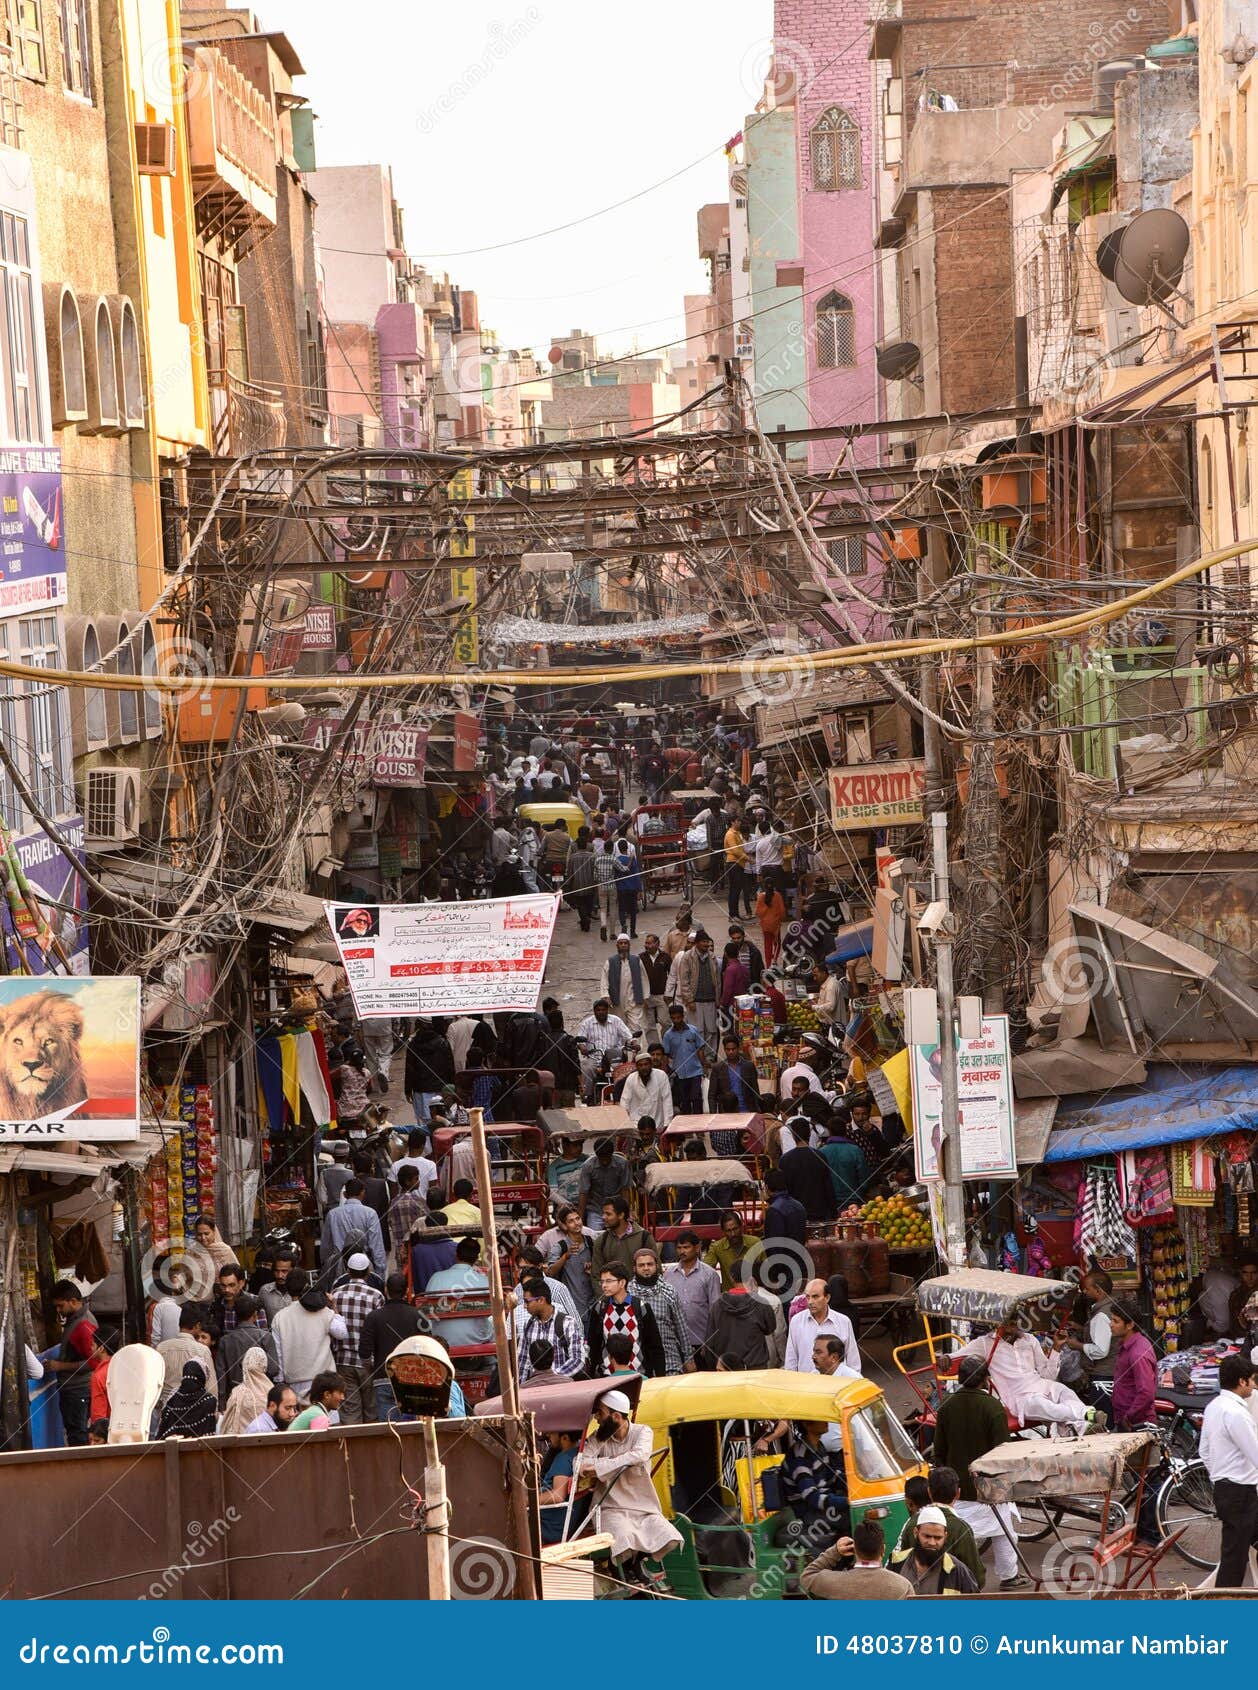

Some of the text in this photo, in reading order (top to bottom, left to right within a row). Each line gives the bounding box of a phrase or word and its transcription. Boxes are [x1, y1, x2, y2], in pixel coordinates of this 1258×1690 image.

[836, 801, 920, 818] IN SIDE STREE
[18, 837, 53, 870] TRAVEL
[410, 966, 420, 974] 10
[961, 1070, 1002, 1086] मुबारक
